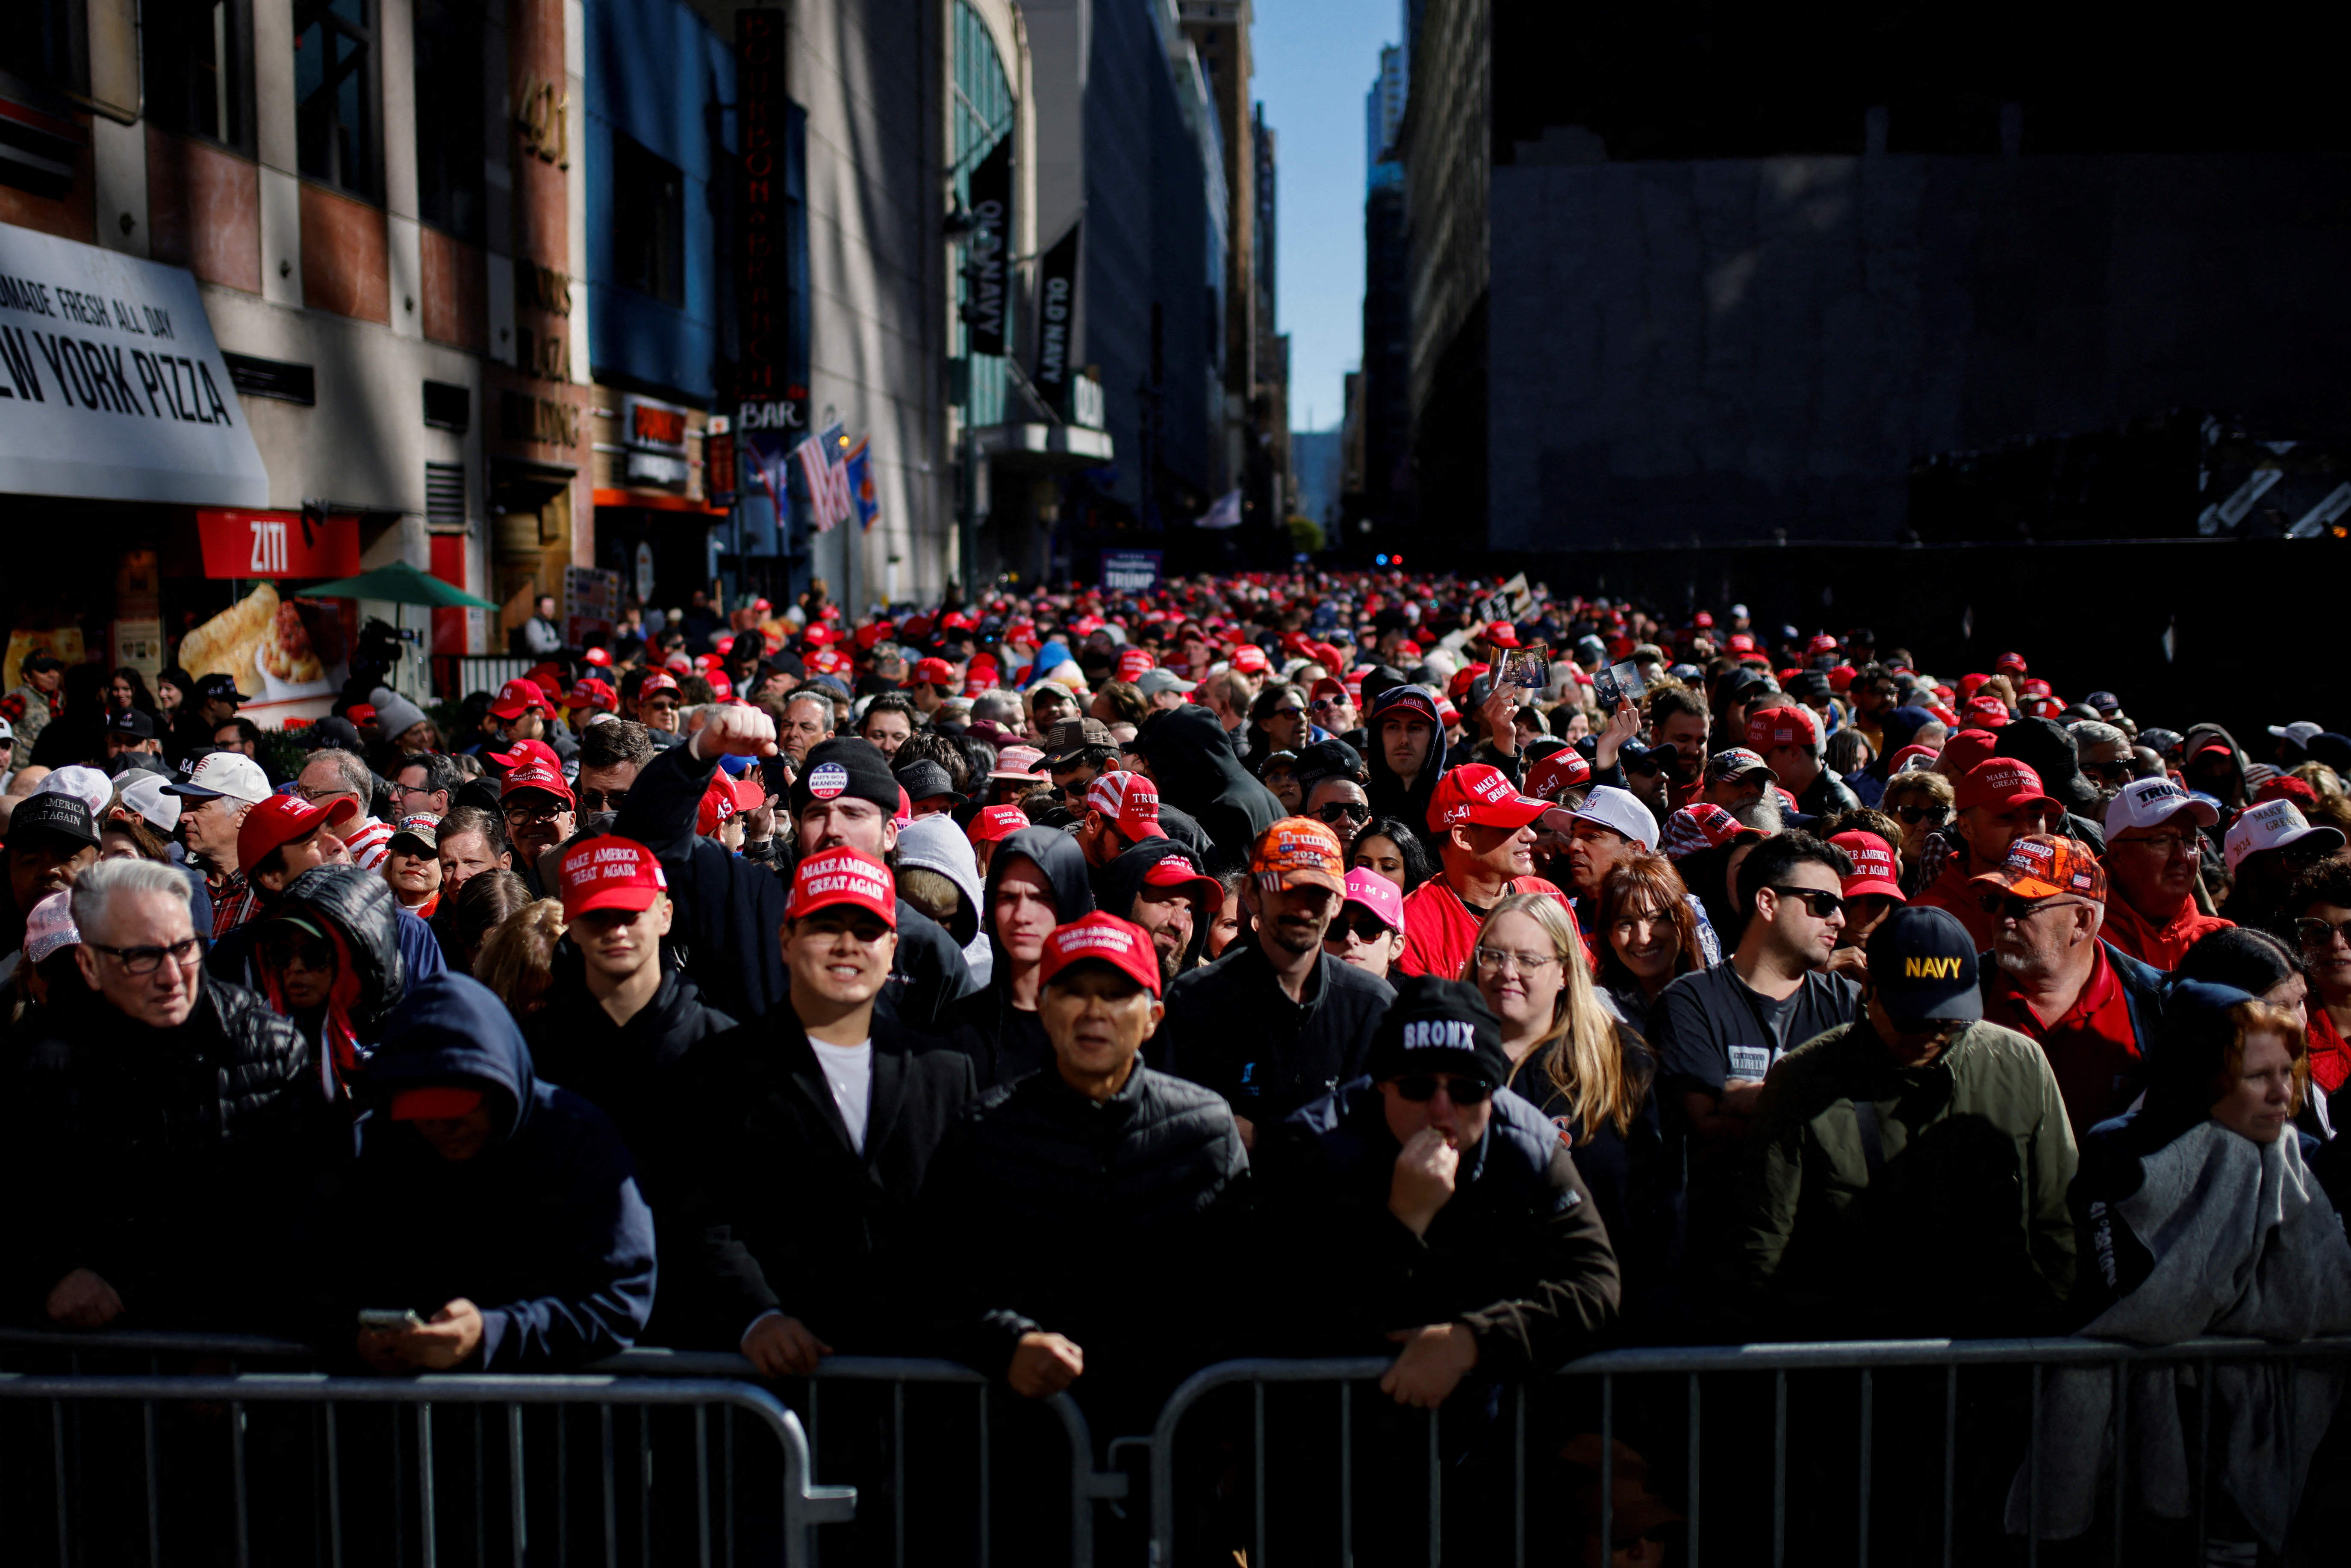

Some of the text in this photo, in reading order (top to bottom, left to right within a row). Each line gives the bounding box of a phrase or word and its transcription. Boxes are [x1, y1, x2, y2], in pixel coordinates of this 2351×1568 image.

[55, 286, 112, 329] FRESH
[112, 299, 144, 334] ALL
[142, 305, 175, 340] DAY
[1043, 277, 1068, 384] OLD NAVY
[32, 330, 145, 417] YORK
[131, 349, 233, 427] PIZZA
[738, 401, 804, 429] BAR
[250, 521, 288, 572] ZITI
[1105, 571, 1155, 590] TRUMP
[1402, 698, 1423, 709] AGAIN
[527, 768, 554, 779] AMERICA
[532, 774, 551, 782] AGAIN
[903, 767, 926, 780] MAKE
[1300, 767, 1326, 780] AMERICA
[1986, 769, 2039, 782] MAKE AMERICA
[911, 778, 936, 789] GREAT
[1473, 775, 1497, 795] MAKE
[1535, 773, 1559, 799] 45-47
[1992, 778, 2040, 789] GREAT AGAIN
[1487, 784, 1510, 803] GREAT
[2141, 800, 2154, 808] MAKE
[2155, 795, 2175, 803] AMERICA
[42, 798, 86, 816] AMERICA
[717, 797, 732, 819] 45
[1444, 803, 1470, 824] 45-47
[2252, 806, 2283, 822] MAKE
[18, 811, 81, 827] GREAT AGAIN
[403, 815, 440, 825] Trump
[2265, 817, 2298, 832] GREAT
[1717, 825, 1726, 834] TAKE
[1279, 831, 1332, 852] Trump
[2012, 839, 2054, 858] Trump
[2233, 837, 2251, 858] 2024
[566, 847, 640, 872] MAKE AMERICA
[1292, 850, 1322, 861] 2024
[1847, 849, 1891, 863] KE AMERICA
[2008, 854, 2032, 864] 2024
[571, 863, 636, 887] GREAT AGAIN
[801, 856, 890, 887] MAKE AMERICA
[1868, 865, 1889, 877] AGAIN
[2024, 864, 2041, 875] BACK
[807, 875, 884, 902] GREAT AGAIN
[1349, 883, 1389, 900] UMP
[37, 903, 73, 931] TRU
[1905, 956, 1962, 979] NAVY
[1403, 1020, 1475, 1050] BRONX
[1734, 1059, 1765, 1069] ADVISORY
